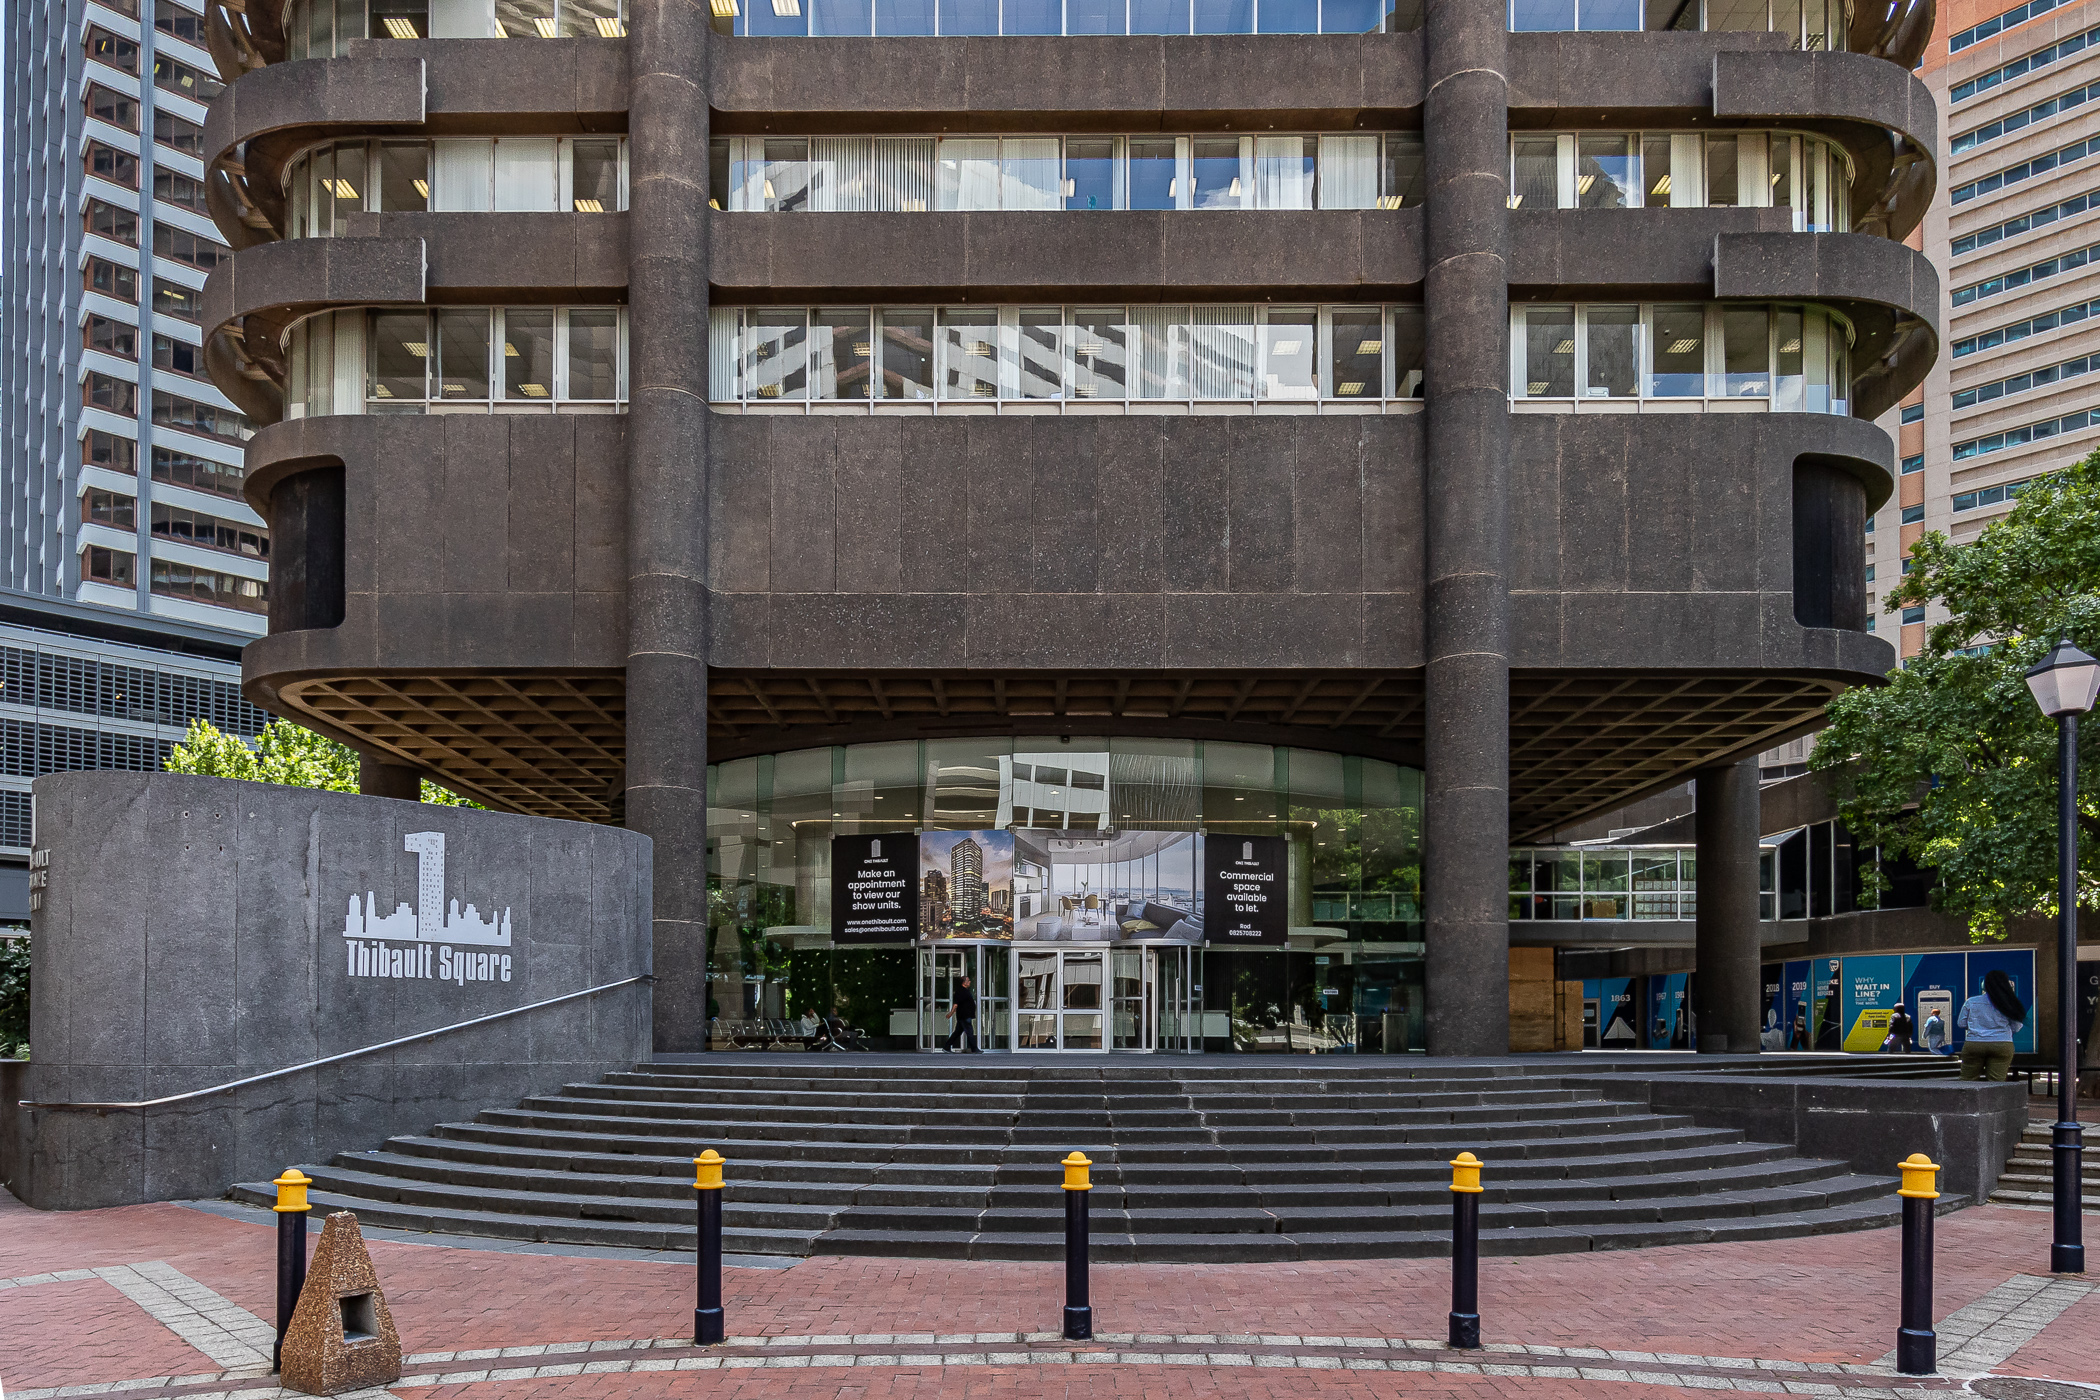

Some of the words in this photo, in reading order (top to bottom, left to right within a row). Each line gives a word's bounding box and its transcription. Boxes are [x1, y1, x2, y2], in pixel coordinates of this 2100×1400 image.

[857, 870, 882, 878] Make
[1219, 871, 1274, 882] Commercial
[847, 879, 906, 891] appointment
[1233, 883, 1261, 892] space
[852, 892, 862, 900] to
[863, 890, 884, 899] view
[1226, 892, 1267, 902] available
[852, 902, 876, 910] show
[877, 900, 901, 909] units.
[1235, 904, 1244, 912] to
[1245, 904, 1259, 913] let.
[346, 940, 433, 979] Thibault
[439, 945, 512, 987] Square
[1766, 984, 1779, 992] 2018
[1792, 982, 1807, 991] 2019
[1855, 983, 1878, 991] WAIT
[1611, 994, 1631, 1002] 1863
